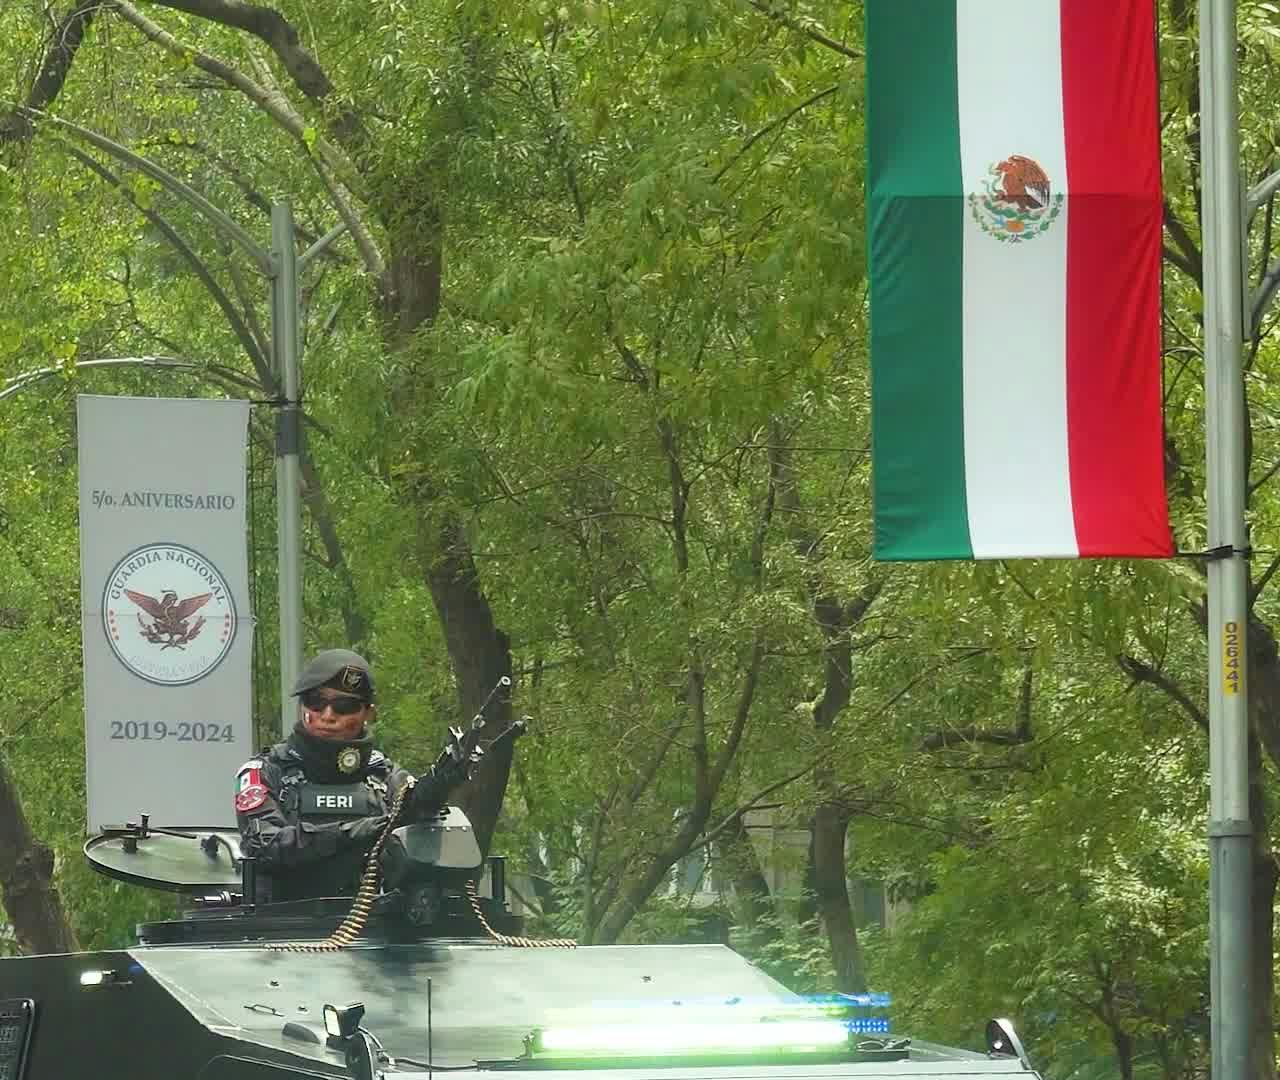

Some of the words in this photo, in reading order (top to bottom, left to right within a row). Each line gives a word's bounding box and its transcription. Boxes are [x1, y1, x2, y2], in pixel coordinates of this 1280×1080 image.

[120, 491, 236, 511] ANIVERSARIO
[110, 551, 162, 601] GUARDIA
[165, 551, 226, 605] NACIONAL
[1225, 622, 1239, 693] 026441
[110, 720, 236, 743] 2019-2024
[316, 794, 353, 808] FERI
